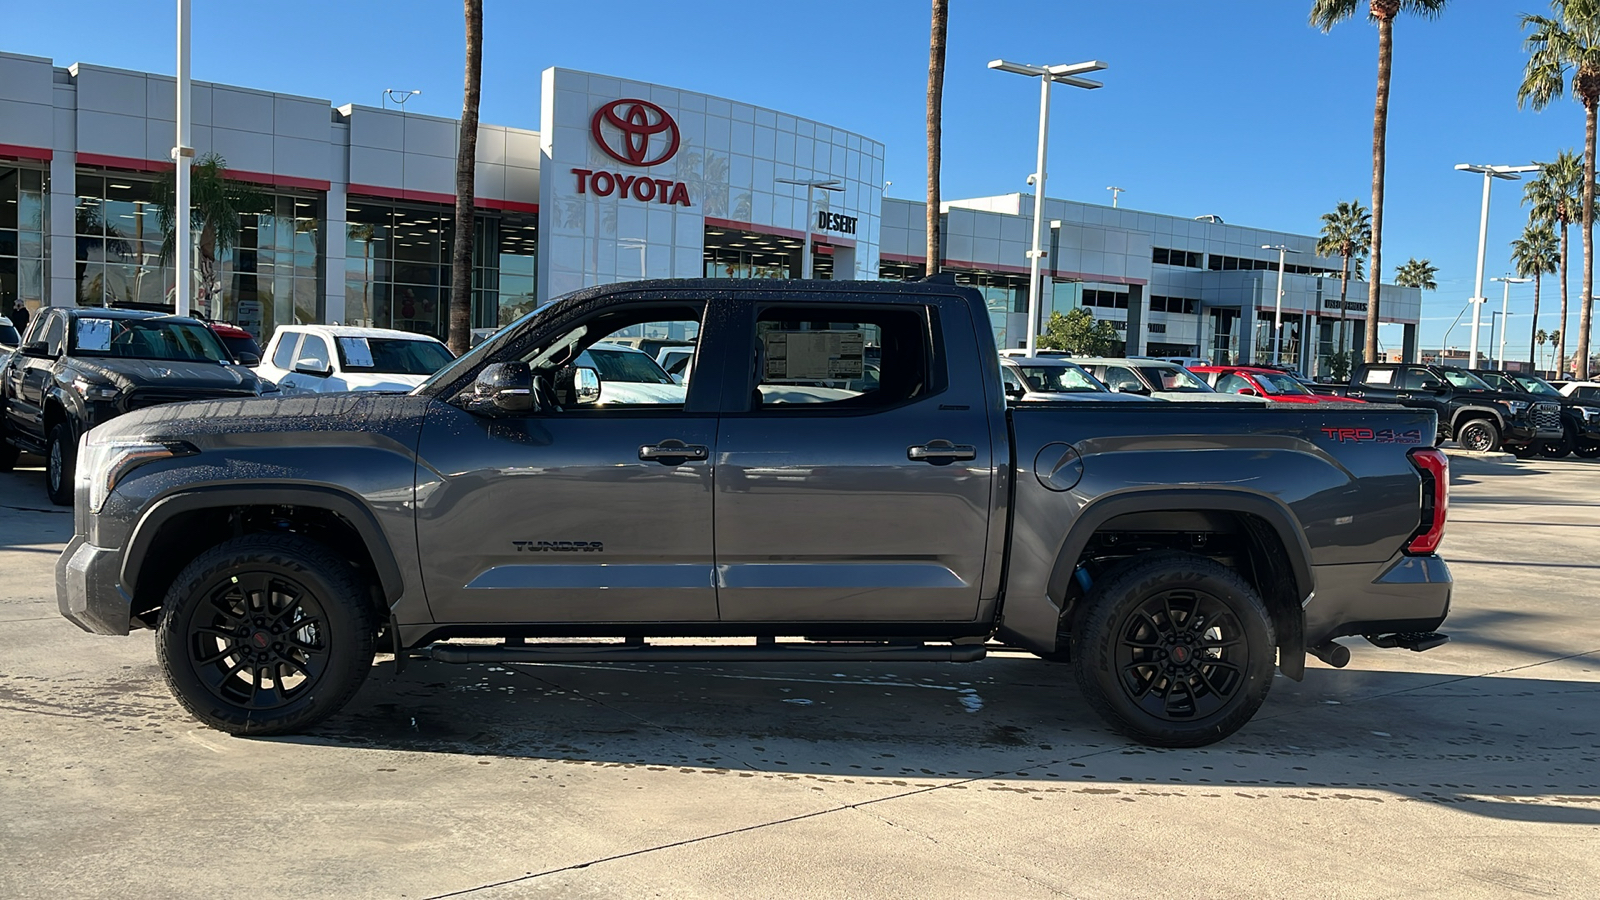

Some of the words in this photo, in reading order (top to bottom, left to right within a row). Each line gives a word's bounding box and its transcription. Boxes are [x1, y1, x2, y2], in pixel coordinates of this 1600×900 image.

[571, 168, 691, 207] TOYOTA
[818, 210, 858, 235] DESERT
[1321, 428, 1374, 442] TRD
[1376, 429, 1421, 440] 4x4
[512, 541, 604, 552] TUNDRA
